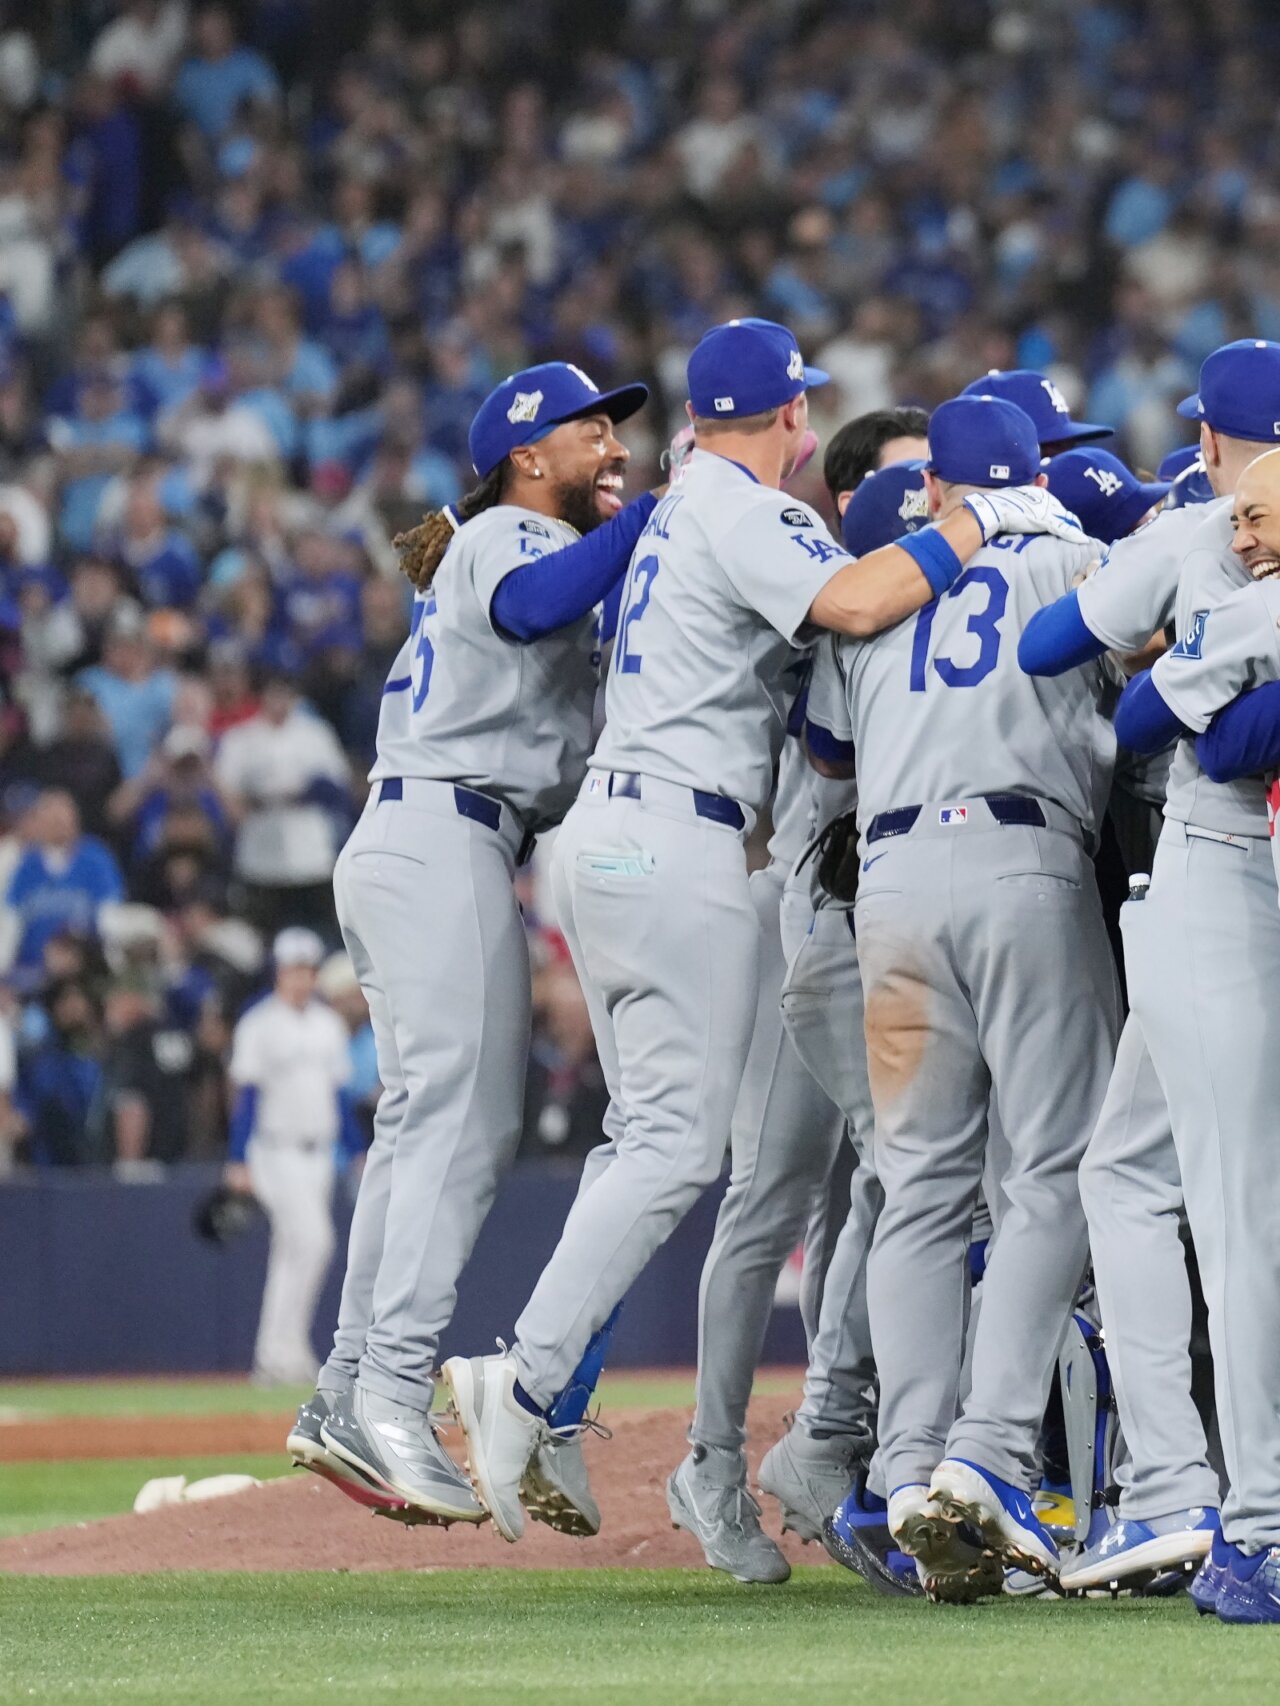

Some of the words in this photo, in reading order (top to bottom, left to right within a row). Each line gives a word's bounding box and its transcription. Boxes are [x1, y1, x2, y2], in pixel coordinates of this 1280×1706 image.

[1083, 467, 1123, 497] LA
[641, 495, 685, 540] ALL
[790, 533, 849, 564] LA
[909, 565, 1010, 693] 13
